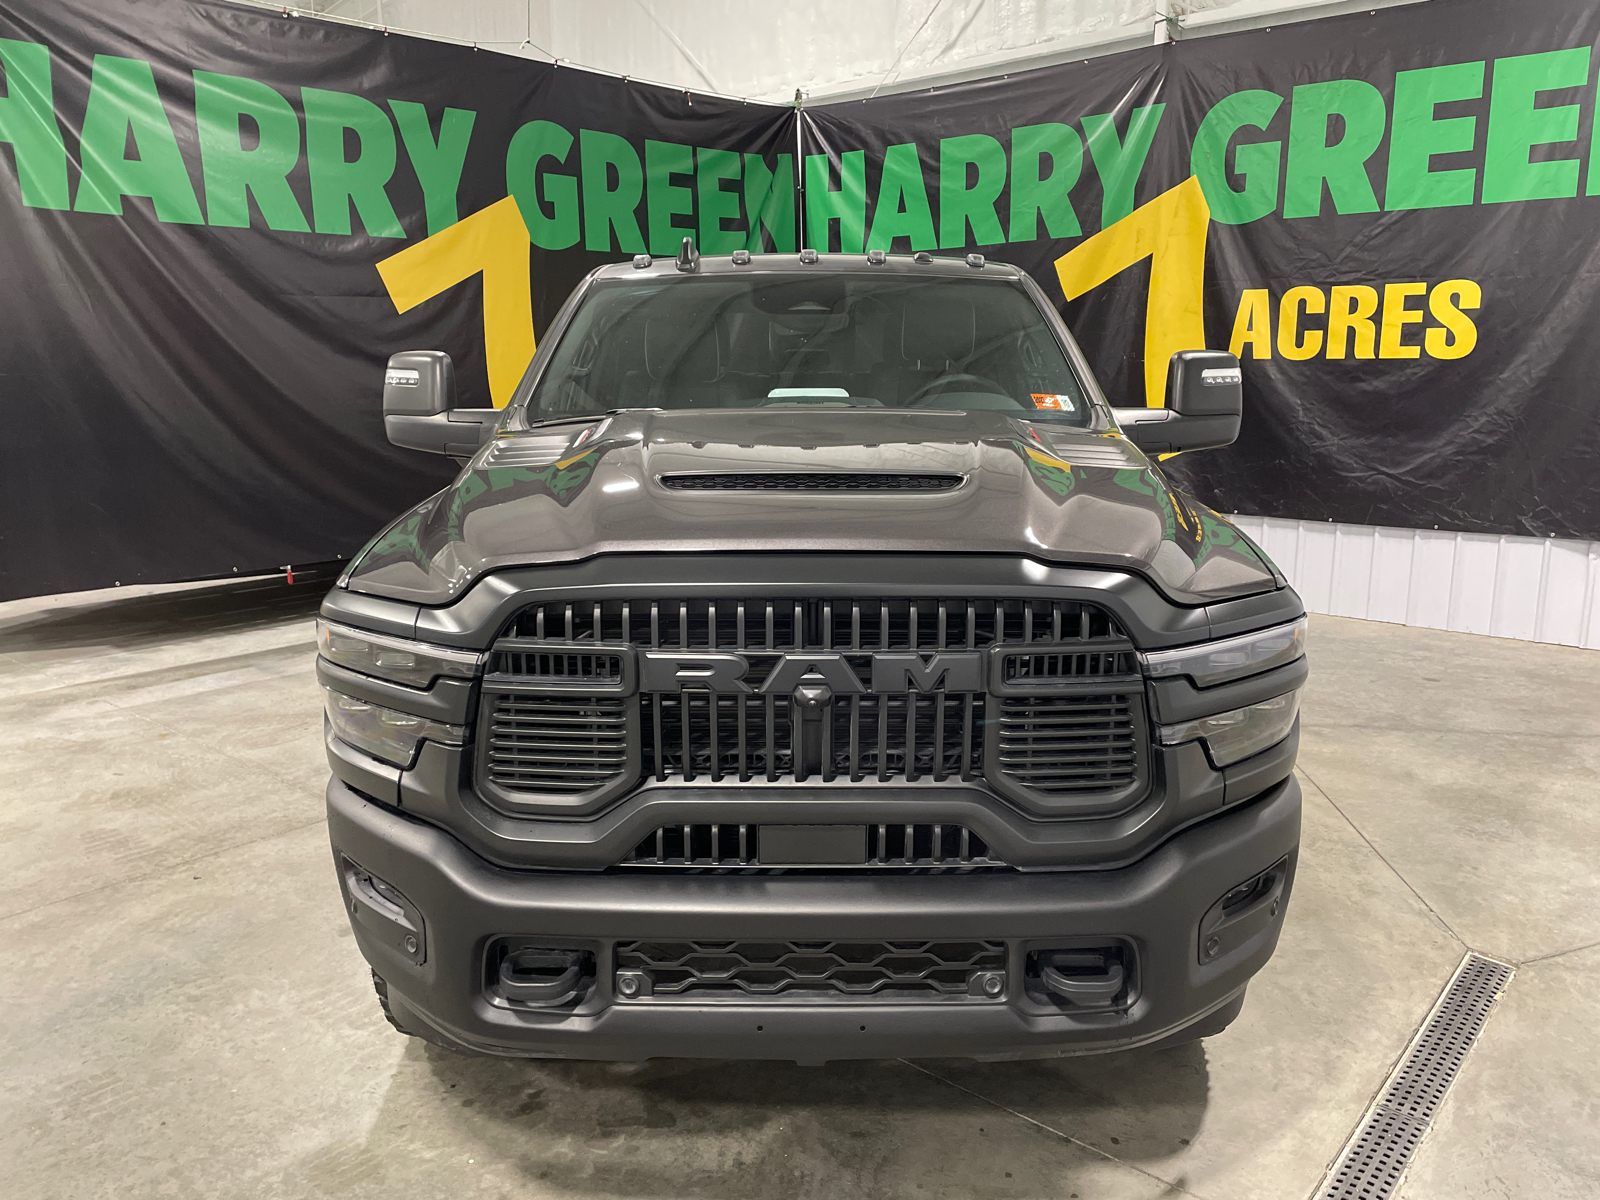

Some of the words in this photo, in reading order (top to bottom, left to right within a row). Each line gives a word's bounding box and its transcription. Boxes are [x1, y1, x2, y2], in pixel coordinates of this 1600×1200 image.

[505, 119, 796, 255] GREEN
[805, 103, 1166, 253] HARRY
[1191, 46, 1600, 226] GREE
[375, 194, 537, 409] 7
[1054, 174, 1210, 461] 7
[1229, 279, 1482, 361] ACRES
[645, 652, 983, 694] RAM
